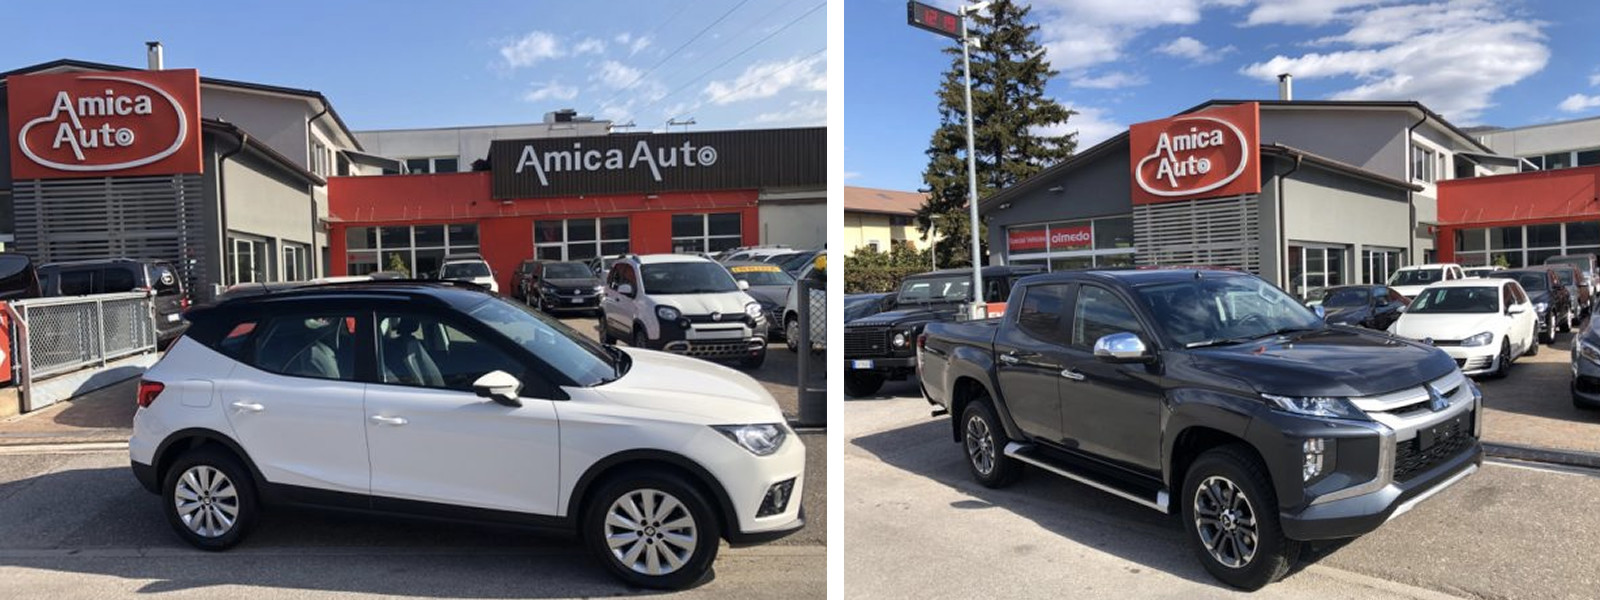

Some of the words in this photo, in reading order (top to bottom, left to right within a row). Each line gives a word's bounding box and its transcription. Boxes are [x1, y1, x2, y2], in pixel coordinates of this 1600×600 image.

[51, 89, 152, 129] Amica
[52, 122, 134, 160] Auto
[1155, 127, 1223, 162] Amica
[515, 142, 623, 186] Amica
[629, 140, 717, 181] Auto
[1156, 155, 1211, 188] Auto
[1051, 231, 1090, 243] olmedo
